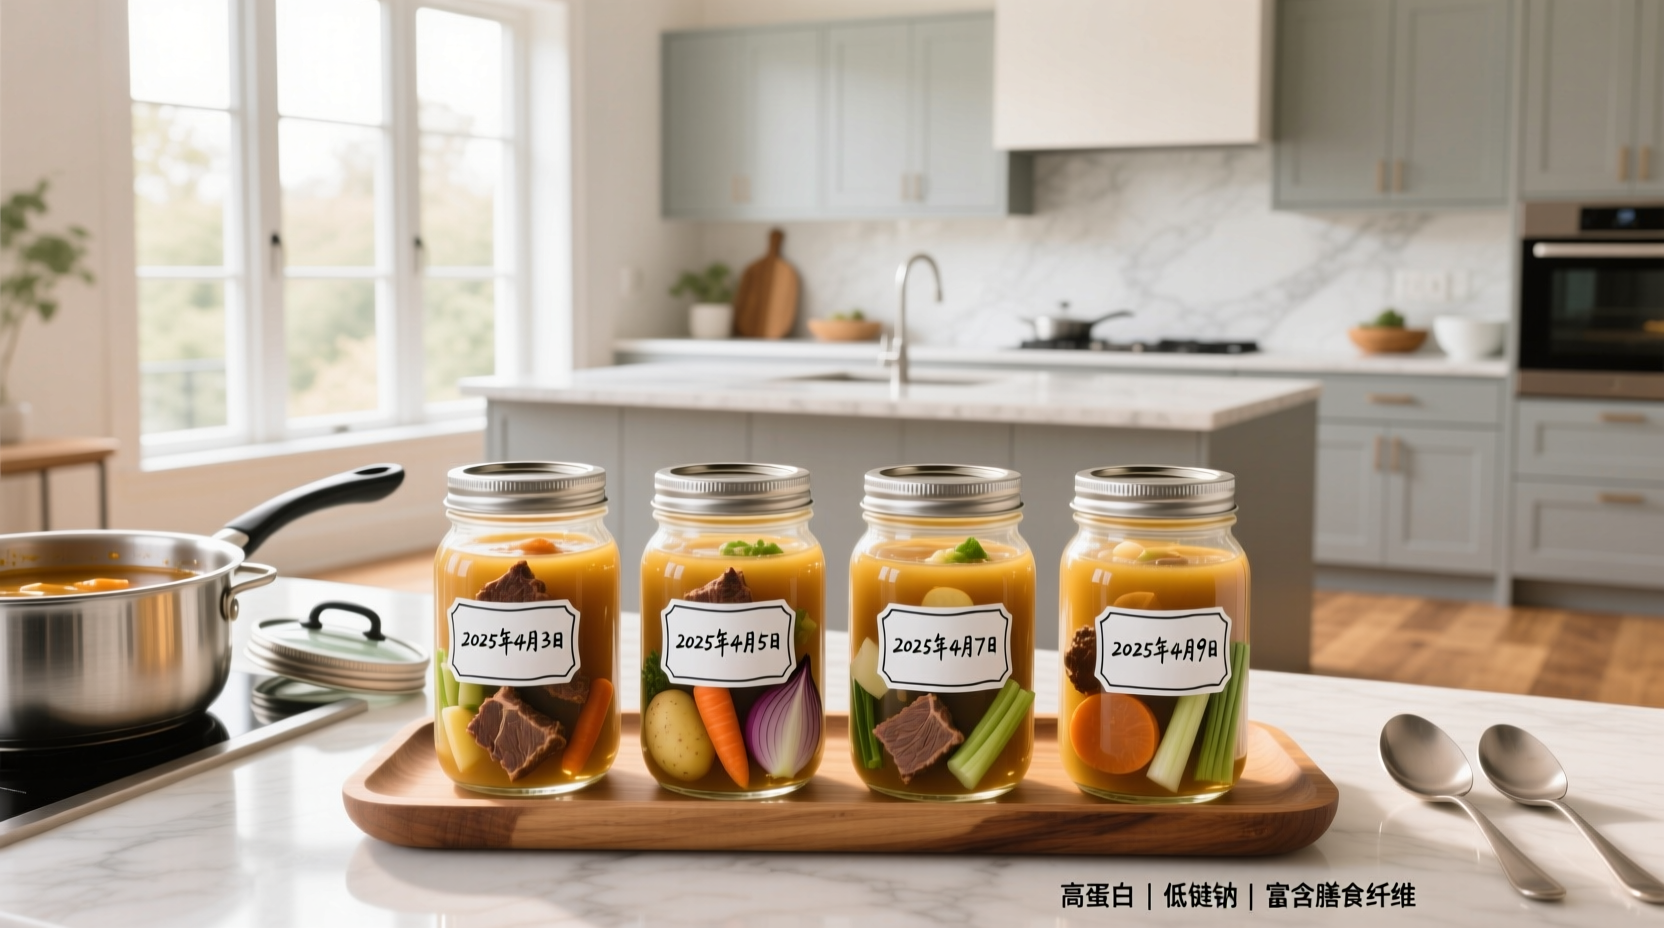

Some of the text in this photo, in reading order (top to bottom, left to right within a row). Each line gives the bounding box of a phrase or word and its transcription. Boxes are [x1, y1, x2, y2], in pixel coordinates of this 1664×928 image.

[461, 627, 563, 656] 2025年4月3日
[675, 628, 780, 658] 2025年4月5日
[892, 632, 997, 661] 2025年4月7日
[1111, 636, 1218, 665] 2025年4月9日
